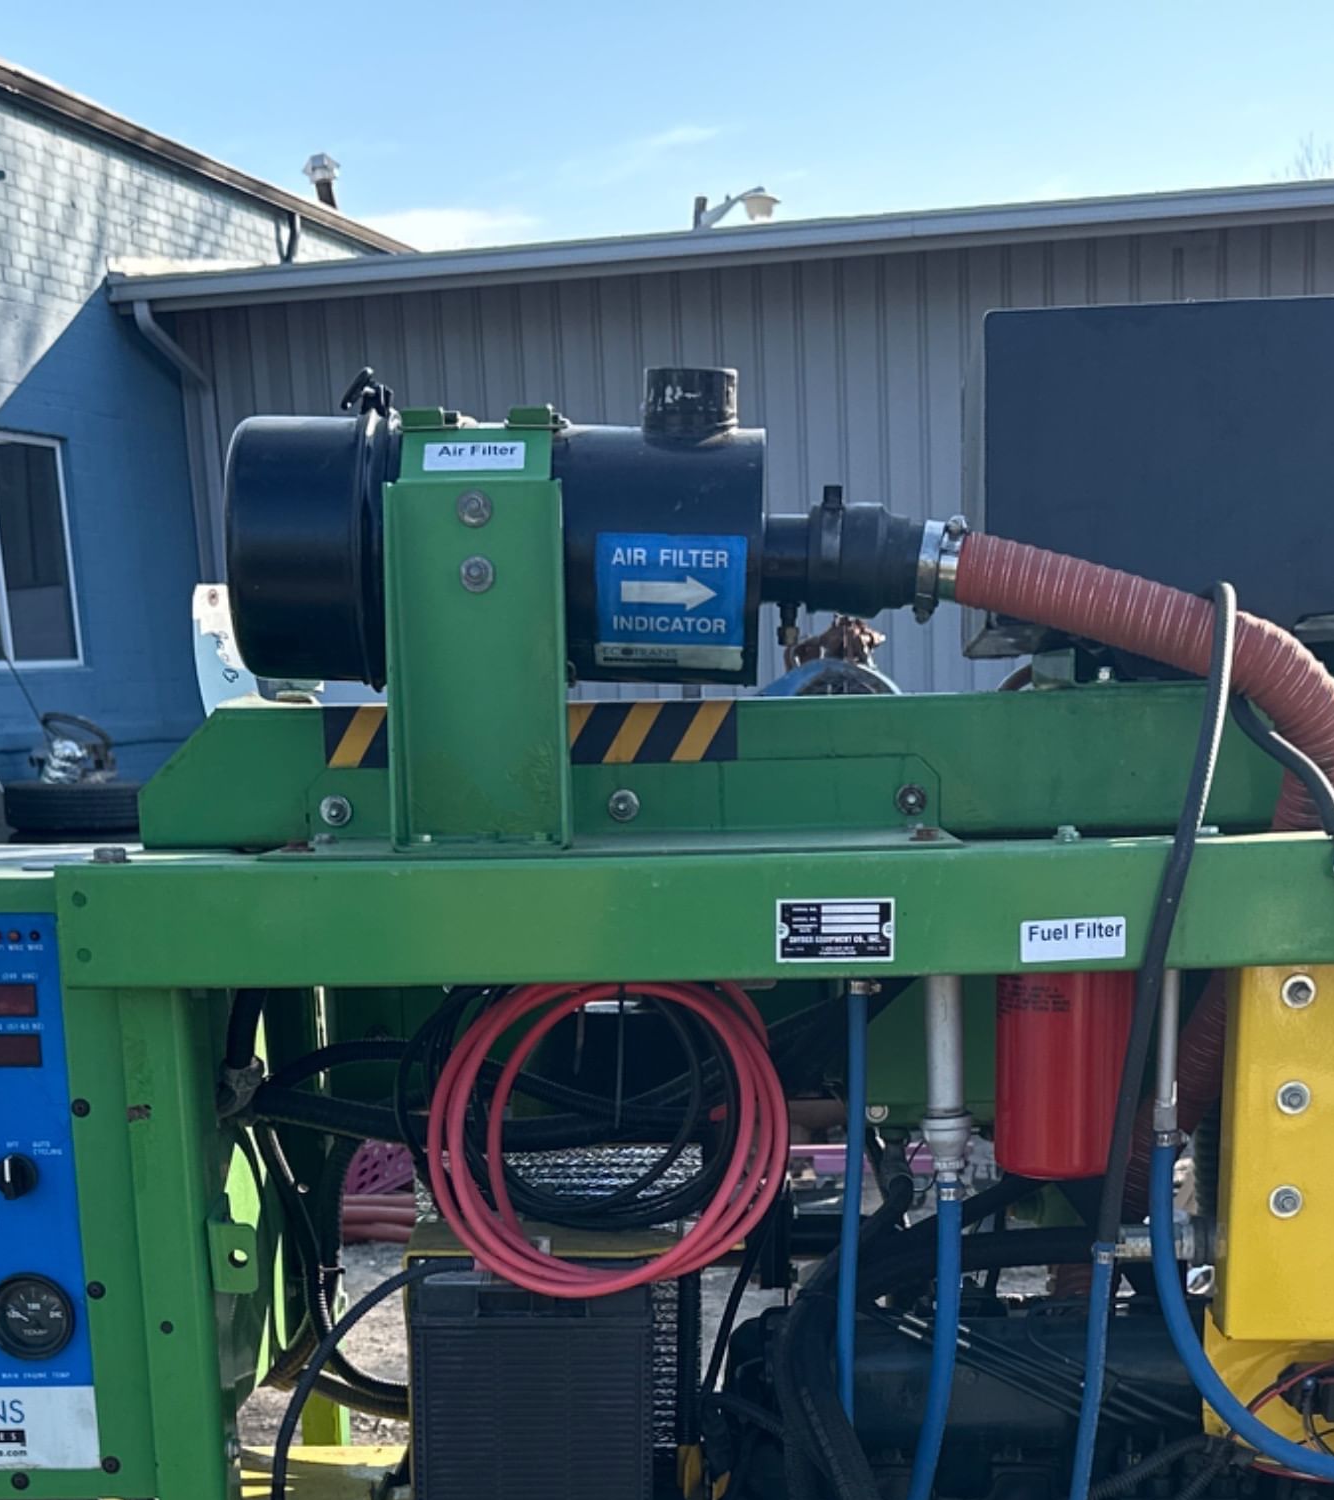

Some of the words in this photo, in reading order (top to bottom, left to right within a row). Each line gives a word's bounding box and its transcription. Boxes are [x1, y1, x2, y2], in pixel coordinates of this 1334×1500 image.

[438, 445, 465, 457] Air
[470, 444, 518, 457] Filter
[611, 547, 647, 566] AIR
[659, 548, 729, 568] FILTER
[612, 615, 727, 633] INDICATOR
[1028, 923, 1068, 942] Fuel
[1075, 922, 1123, 940] Filter
